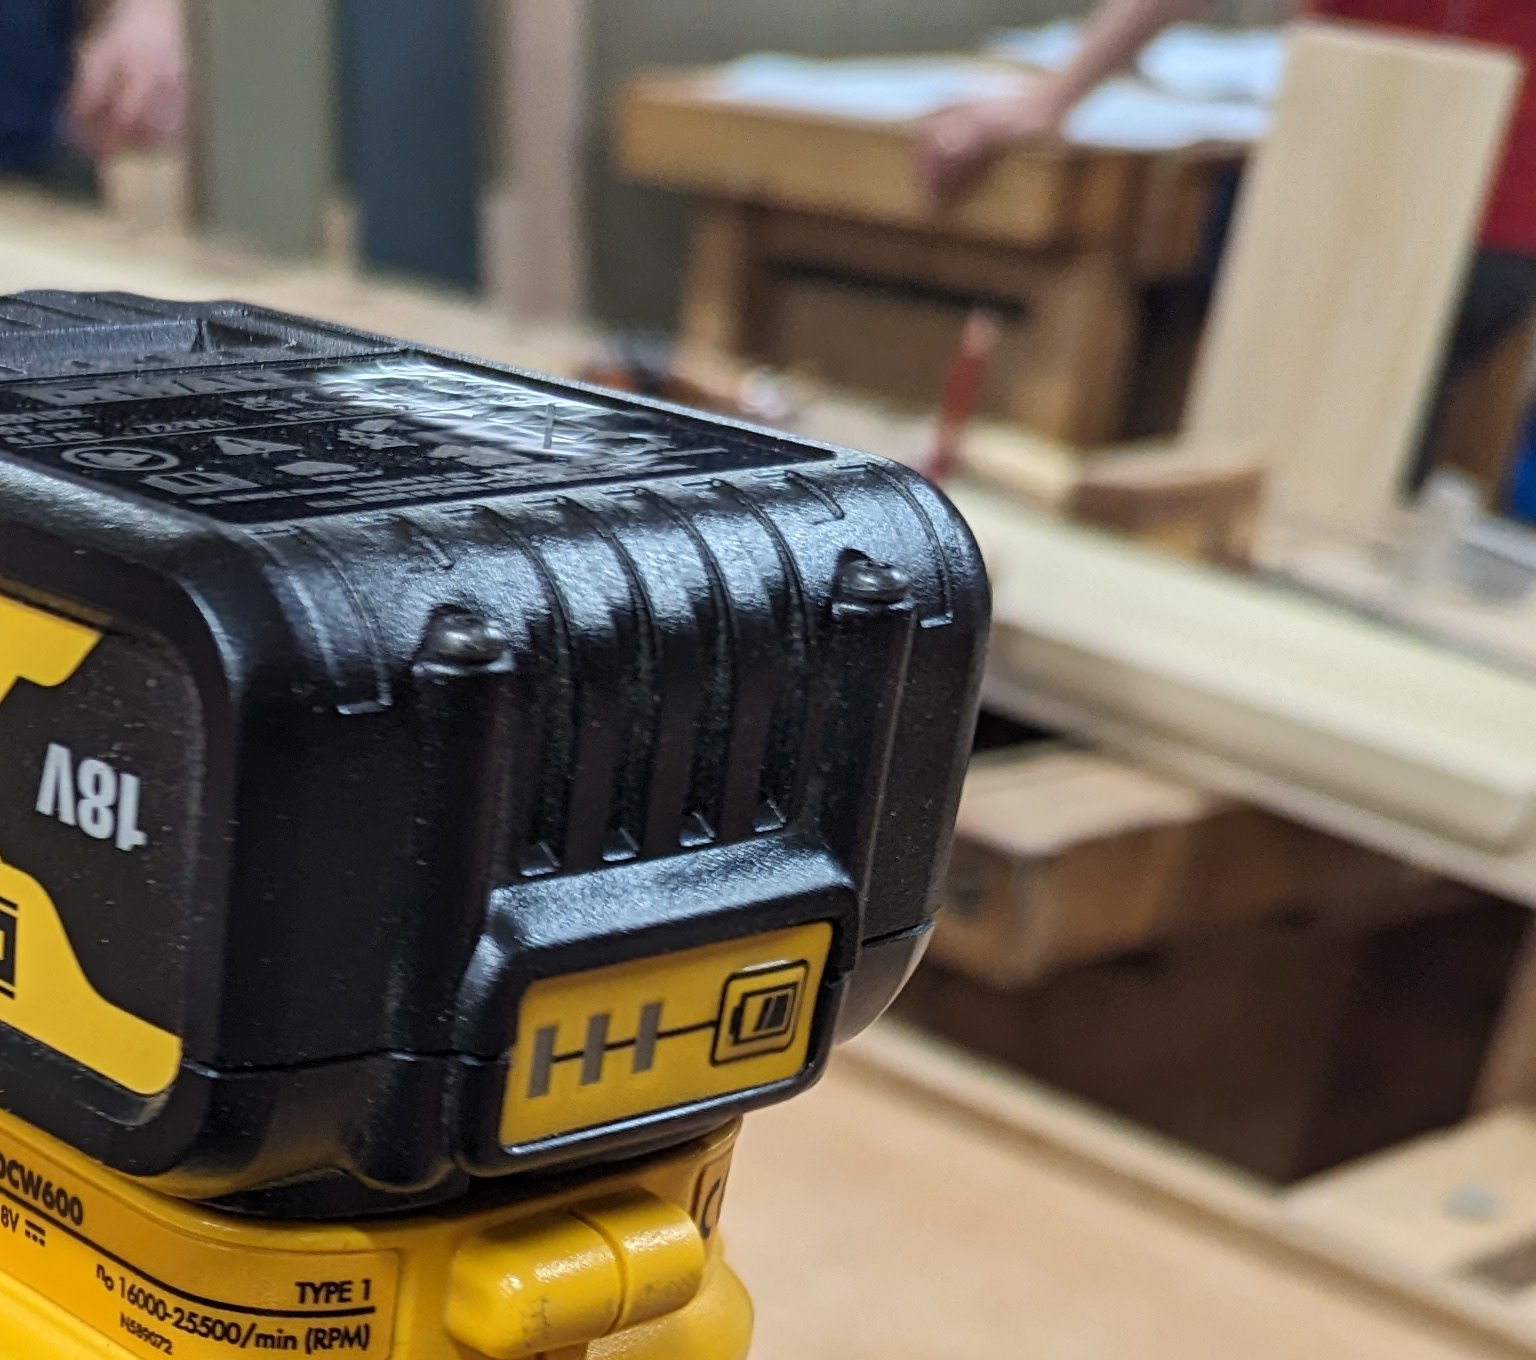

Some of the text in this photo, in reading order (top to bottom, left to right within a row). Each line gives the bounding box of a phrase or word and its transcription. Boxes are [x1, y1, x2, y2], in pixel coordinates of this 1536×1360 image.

[35, 742, 148, 851] 18V
[118, 1276, 298, 1351] 16000-25500/min
[304, 1323, 371, 1355] (RPM)
[295, 1279, 372, 1305] TYPE 1
[119, 1311, 174, 1356] N589072
